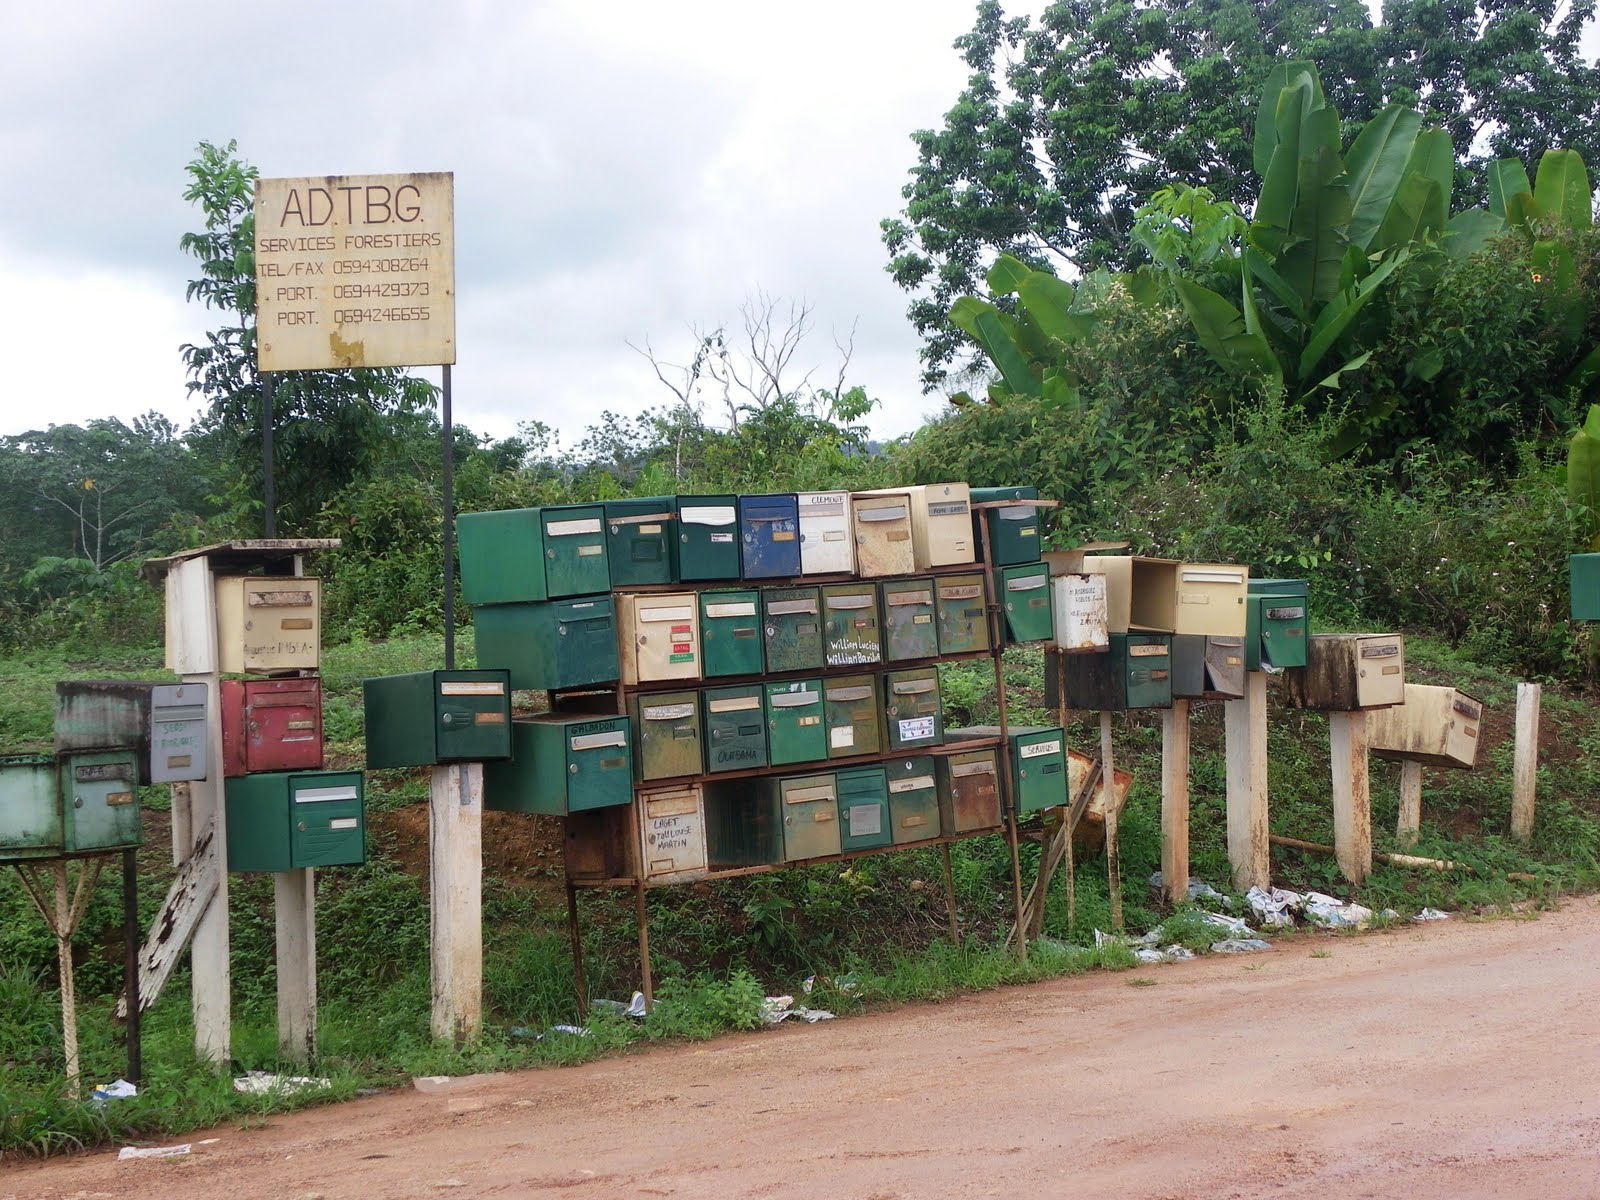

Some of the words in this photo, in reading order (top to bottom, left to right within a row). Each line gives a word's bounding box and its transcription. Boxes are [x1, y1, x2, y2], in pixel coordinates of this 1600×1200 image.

[259, 236, 336, 253] SERVICES
[344, 232, 441, 250] FORESTIERS
[333, 257, 429, 275] 0594308264
[277, 286, 318, 301] PORT.
[333, 282, 430, 299] 0694429373
[277, 311, 319, 326] PORT.
[334, 306, 430, 324] 0694246655
[658, 839, 687, 851] MARTIN
